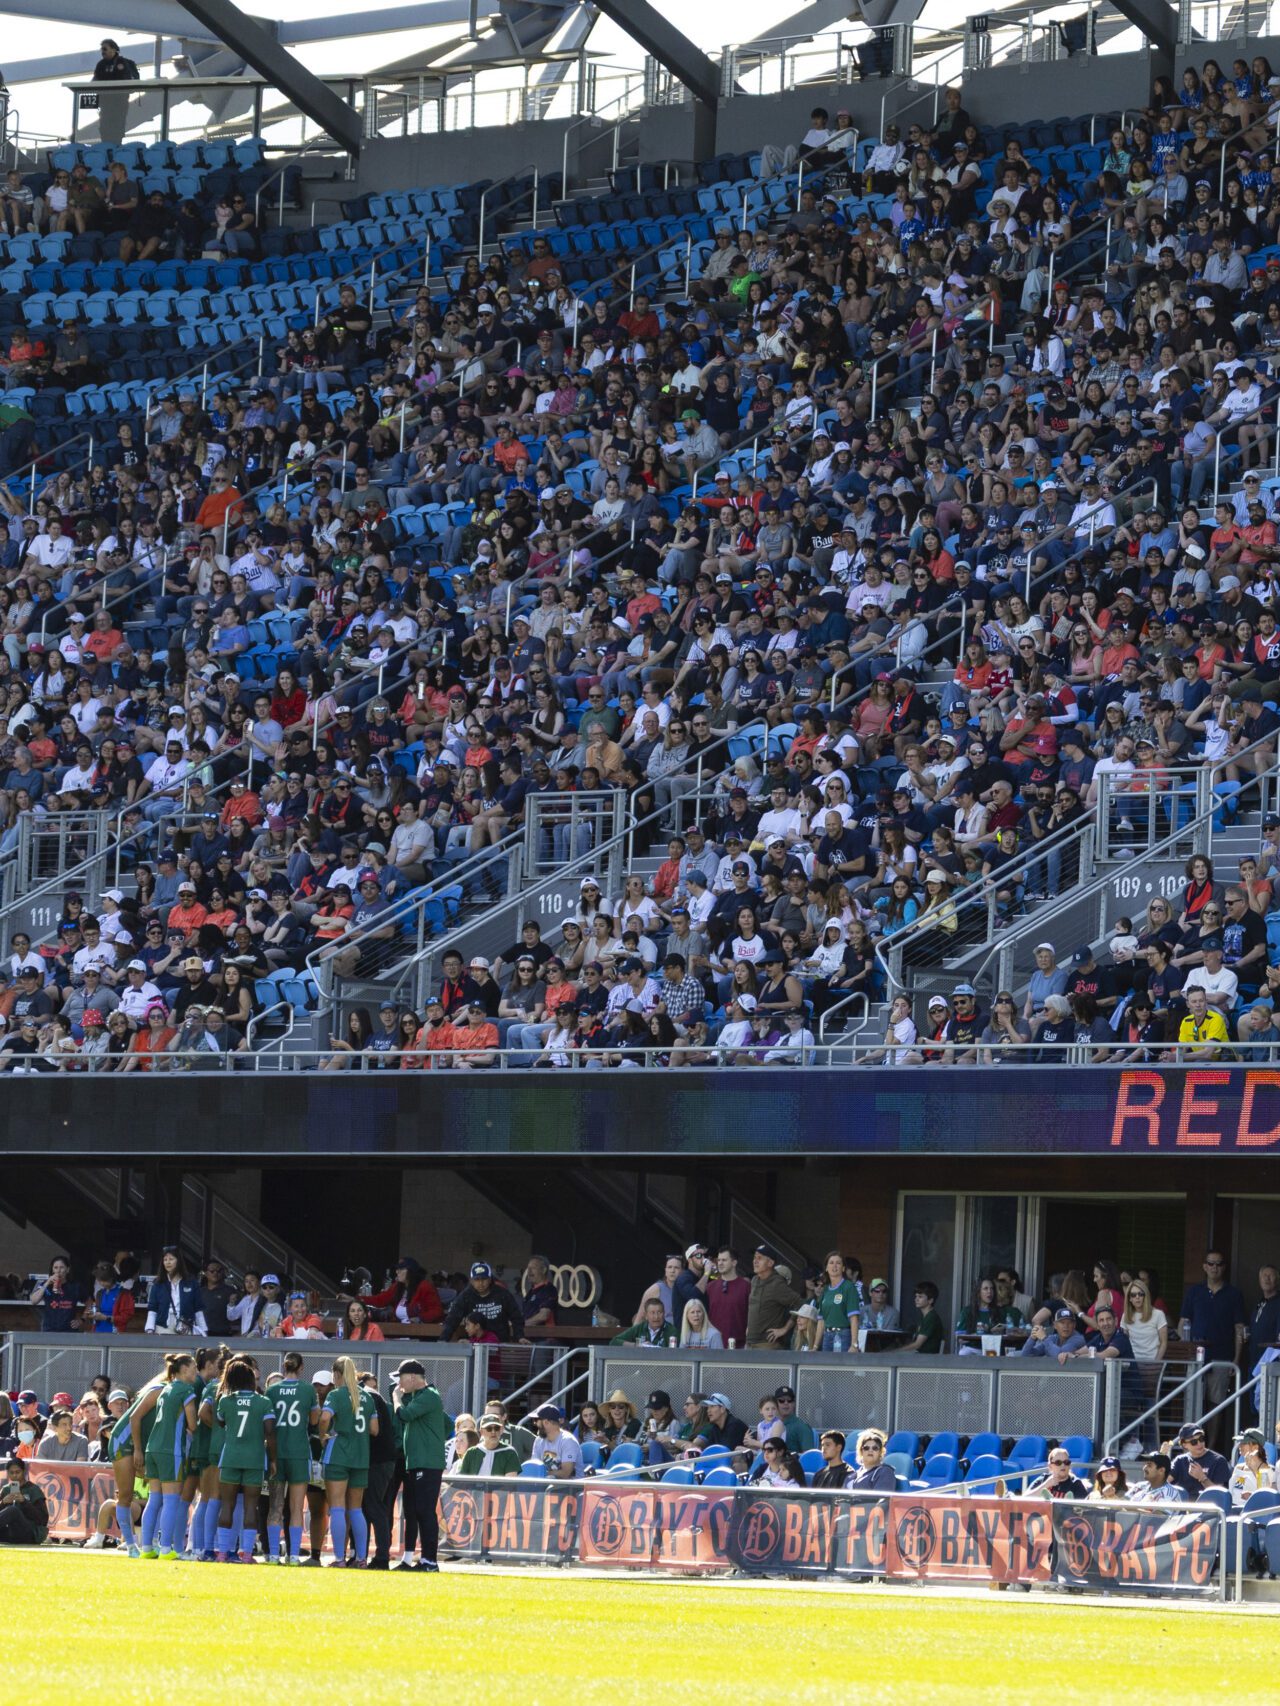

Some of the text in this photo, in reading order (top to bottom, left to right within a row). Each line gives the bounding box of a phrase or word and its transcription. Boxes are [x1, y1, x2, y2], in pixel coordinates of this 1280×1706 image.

[975, 17, 986, 28] 111
[884, 28, 894, 38] 112
[83, 96, 96, 106] 112
[811, 535, 833, 549] Bay
[240, 567, 261, 582] Bay
[1114, 877, 1140, 898] 109
[539, 893, 562, 914] 110
[30, 907, 50, 926] 111
[737, 944, 756, 956] Bay
[1075, 980, 1098, 994] Bay
[279, 1388, 296, 1396] FLINT
[276, 1401, 301, 1427] 26
[355, 1407, 366, 1433] 5
[237, 1411, 249, 1438] 7
[483, 1493, 537, 1550] BAY
[542, 1491, 577, 1552] FC
[783, 1504, 840, 1565] BAY
[846, 1505, 886, 1566] FC
[941, 1510, 1001, 1569] BAY
[1009, 1510, 1052, 1570] FC
[1100, 1521, 1158, 1580] BAY
[1170, 1523, 1211, 1585] FC
